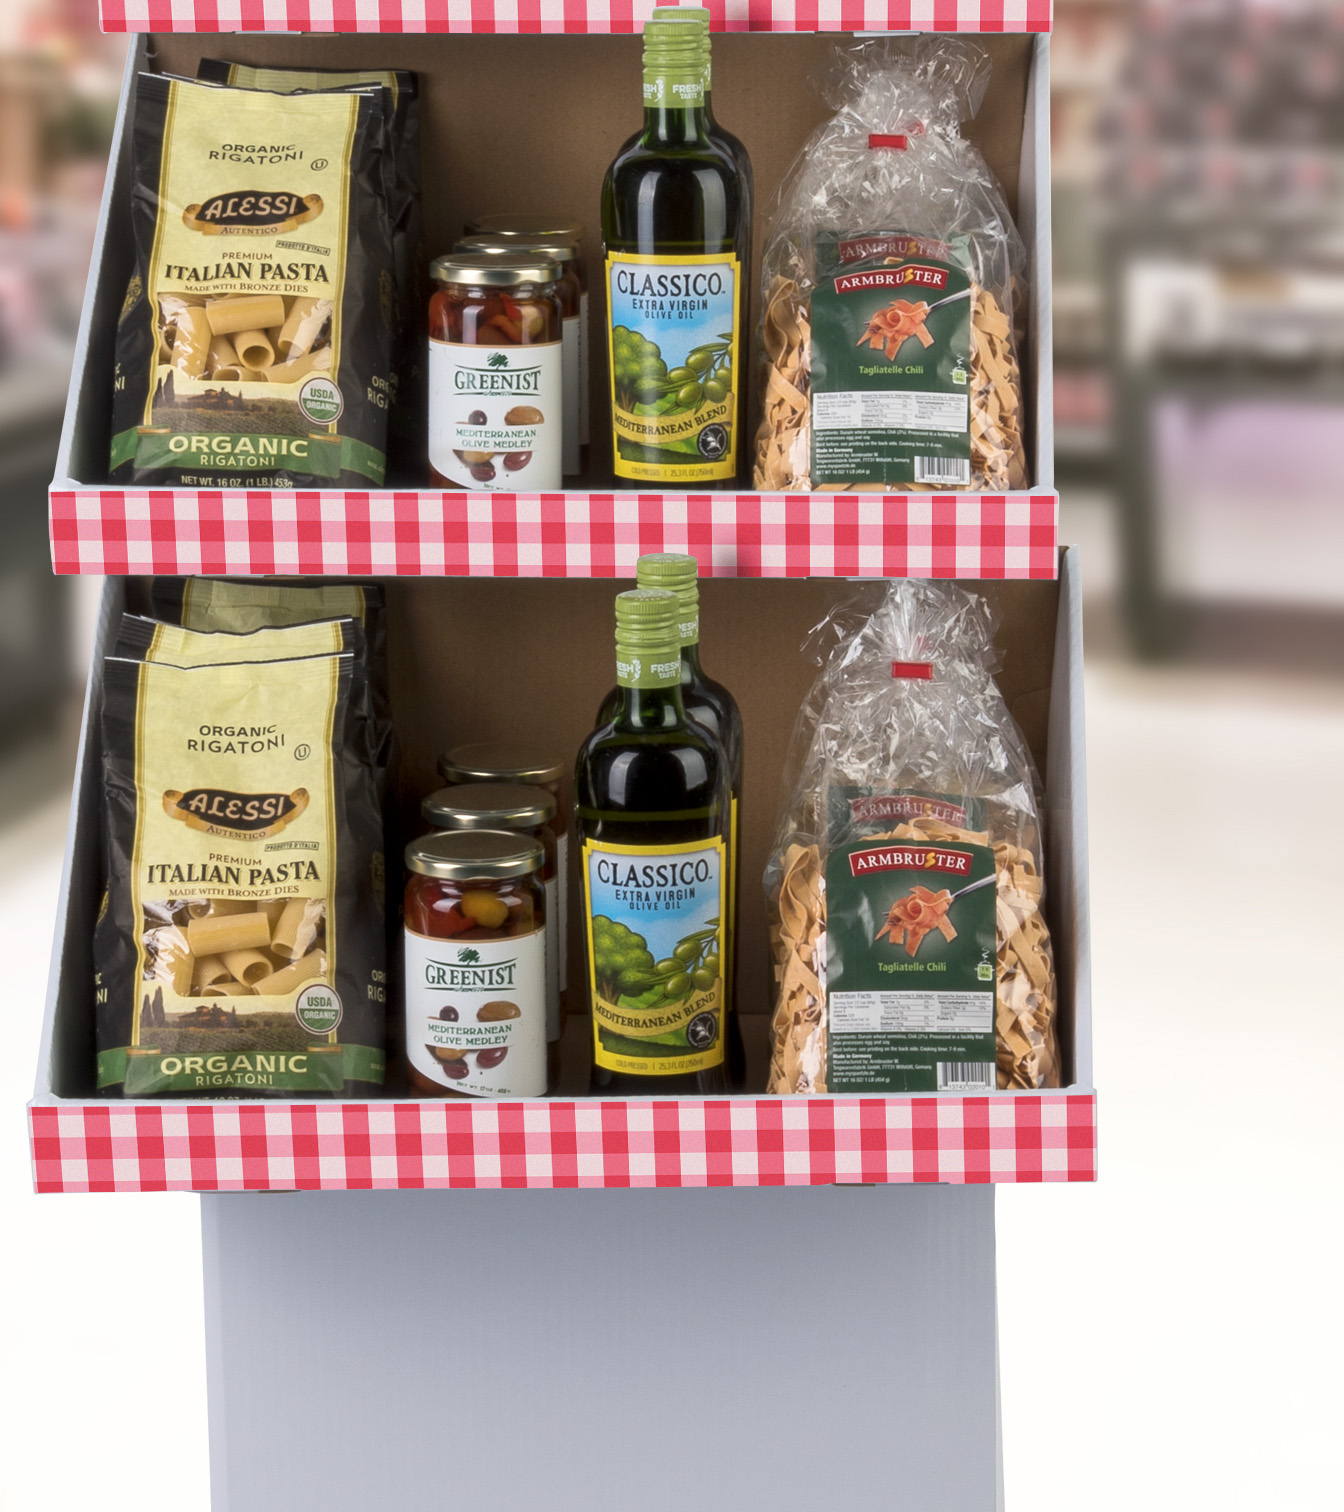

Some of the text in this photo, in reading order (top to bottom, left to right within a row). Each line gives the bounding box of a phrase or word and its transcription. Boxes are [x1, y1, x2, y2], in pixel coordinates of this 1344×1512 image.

[222, 143, 296, 153] ORGANIC
[209, 150, 304, 165] RIGATONI
[205, 194, 298, 220] ALESSI
[220, 225, 278, 236] AUTENTICO
[222, 252, 273, 261] PREMIUM
[164, 262, 330, 283] ITALIAN PASTA
[840, 269, 943, 288] ARMBRUSTER
[185, 284, 211, 292] MADE
[239, 282, 281, 292] BRONZE
[284, 284, 309, 293] DIES
[617, 269, 723, 296] CLASSICO
[632, 298, 708, 310] EXTRA VIRGIN
[644, 311, 694, 319] OLIVE OIL
[859, 365, 924, 376] Tagliatelle Chili
[454, 369, 541, 391] GREENIST
[310, 387, 334, 400] USDA
[306, 400, 337, 412] ORGANIC
[614, 405, 727, 435] MEDITERRANEAN BLEND
[456, 429, 536, 438] MEDITERRANEAN
[168, 434, 309, 457] ORGANIC
[462, 440, 533, 448] OLIVE MEDLEY
[199, 454, 275, 467] RIGATONI
[181, 475, 197, 485] NET
[198, 476, 214, 486] WT.
[217, 476, 227, 486] 16
[228, 476, 244, 486] OZ.
[255, 476, 273, 488] LB.)
[199, 724, 276, 738] ORGANIC
[187, 734, 285, 754] RIGATONI
[189, 793, 285, 820] ALESSI
[205, 824, 267, 840] AUTENTICO
[209, 853, 262, 866] PREMIUM
[856, 852, 967, 870] ARMBRUSTER
[147, 860, 321, 886] ITALIAN PASTA
[598, 858, 710, 888] CLASSICO
[168, 885, 300, 898] MADE WITH BRONZE DIES
[615, 888, 696, 902] EXTRA VIRGIN
[629, 900, 682, 911] OLIVE OIL
[878, 962, 947, 973] Tagliatelle Chili
[425, 963, 518, 986] GREENIST
[307, 996, 332, 1009] USDA
[303, 1009, 335, 1020] ORGANIC
[595, 992, 716, 1029] MEDITERRANEAN BLEND
[428, 1024, 512, 1035] MEDITERRANEAN
[433, 1035, 509, 1046] OLIVE MEDLEY
[159, 1054, 308, 1075] ORGANIC
[195, 1072, 273, 1087] RIGATONI
